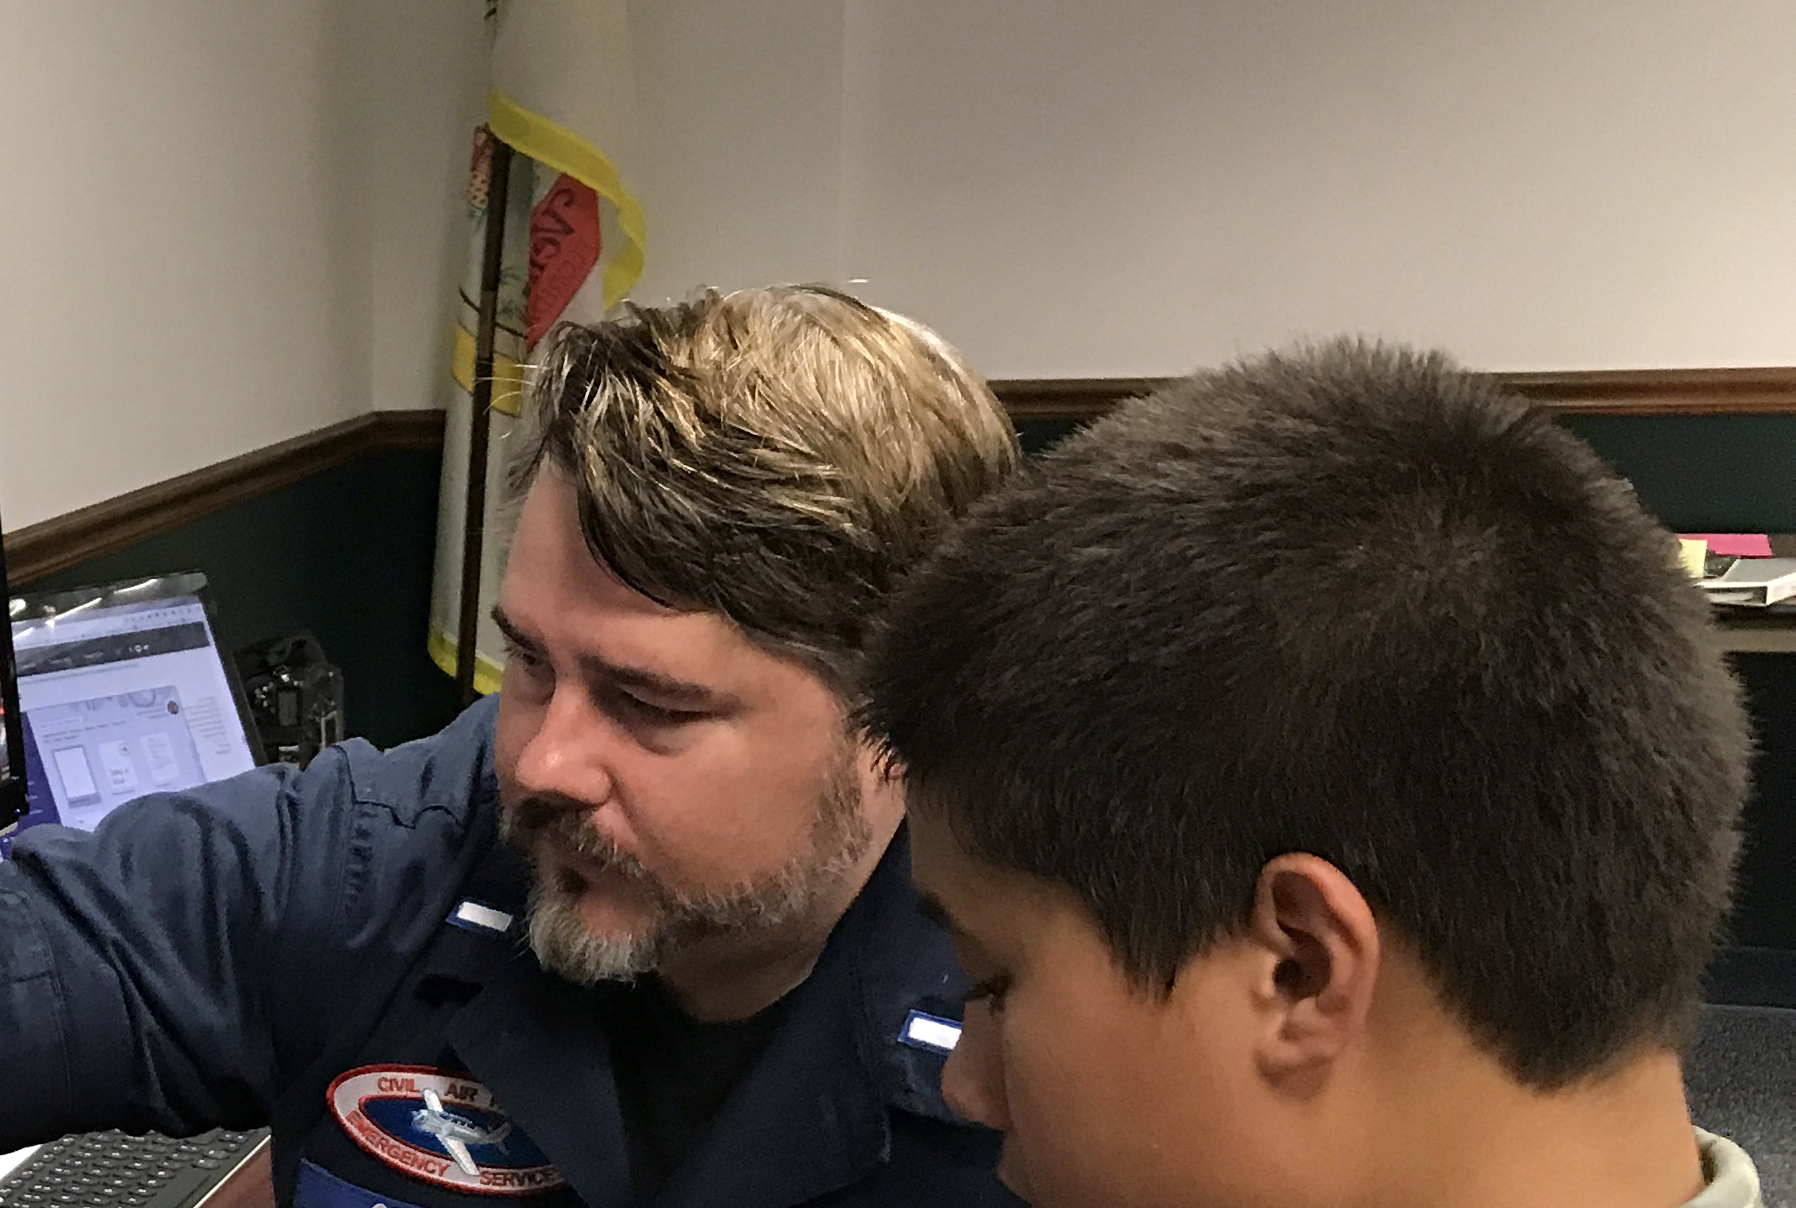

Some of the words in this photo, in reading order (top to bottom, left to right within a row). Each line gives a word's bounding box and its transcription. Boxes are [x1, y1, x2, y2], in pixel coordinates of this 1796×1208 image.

[377, 1076, 421, 1093] CIVIL
[444, 1082, 479, 1103] AIR
[346, 1109, 451, 1178] EMERGENCY
